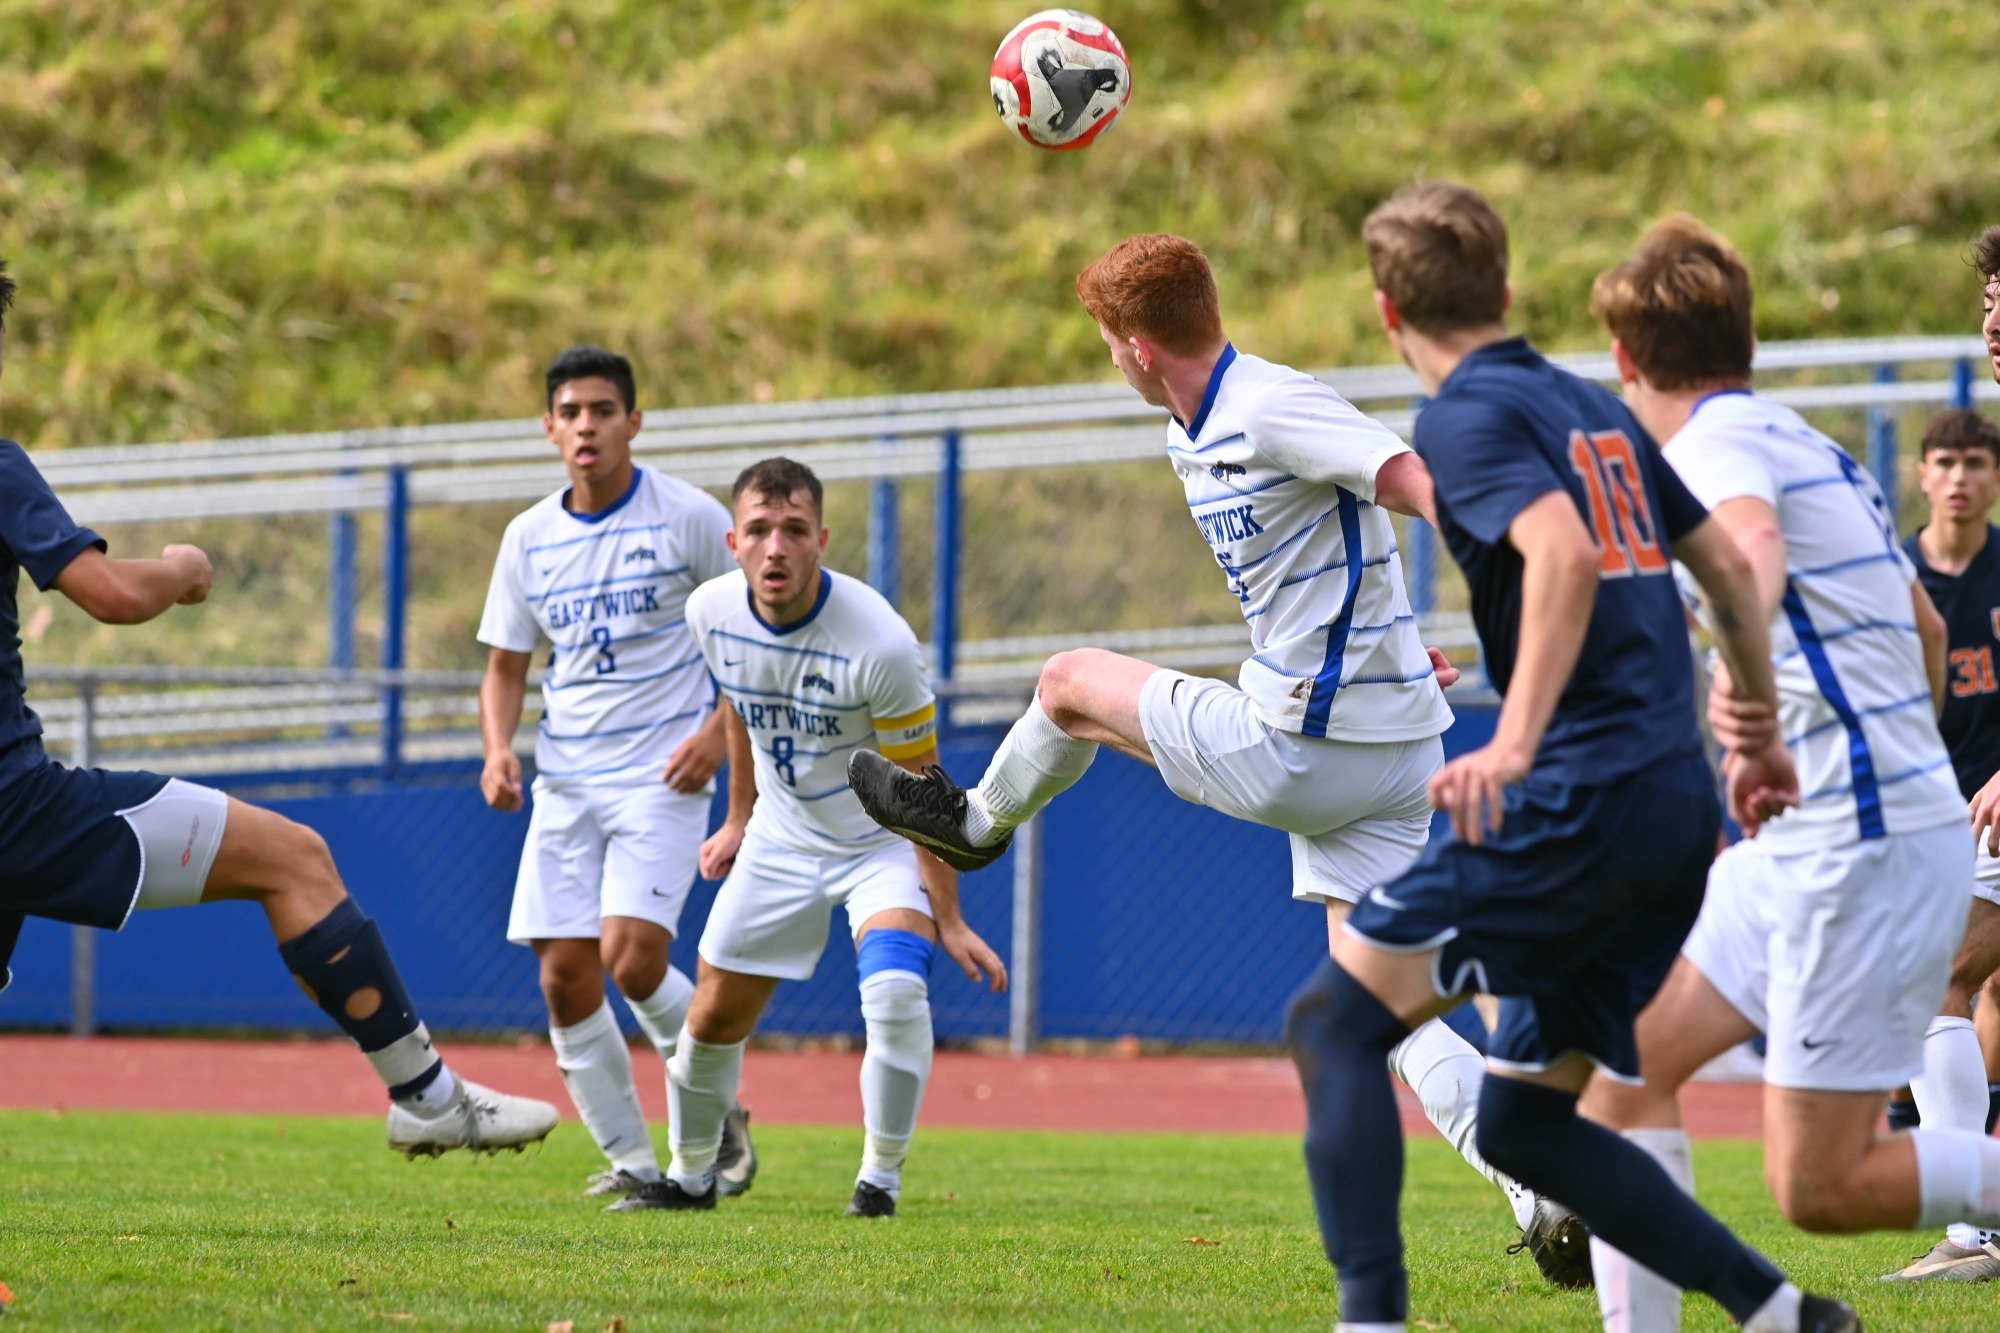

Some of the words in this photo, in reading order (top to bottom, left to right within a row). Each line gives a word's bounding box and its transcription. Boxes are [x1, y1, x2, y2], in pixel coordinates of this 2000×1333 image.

[549, 586, 658, 628] HARTWICK
[592, 627, 615, 674] 3
[1949, 647, 1998, 697] 31
[738, 702, 842, 736] ARTWICK
[772, 736, 796, 787] 8
